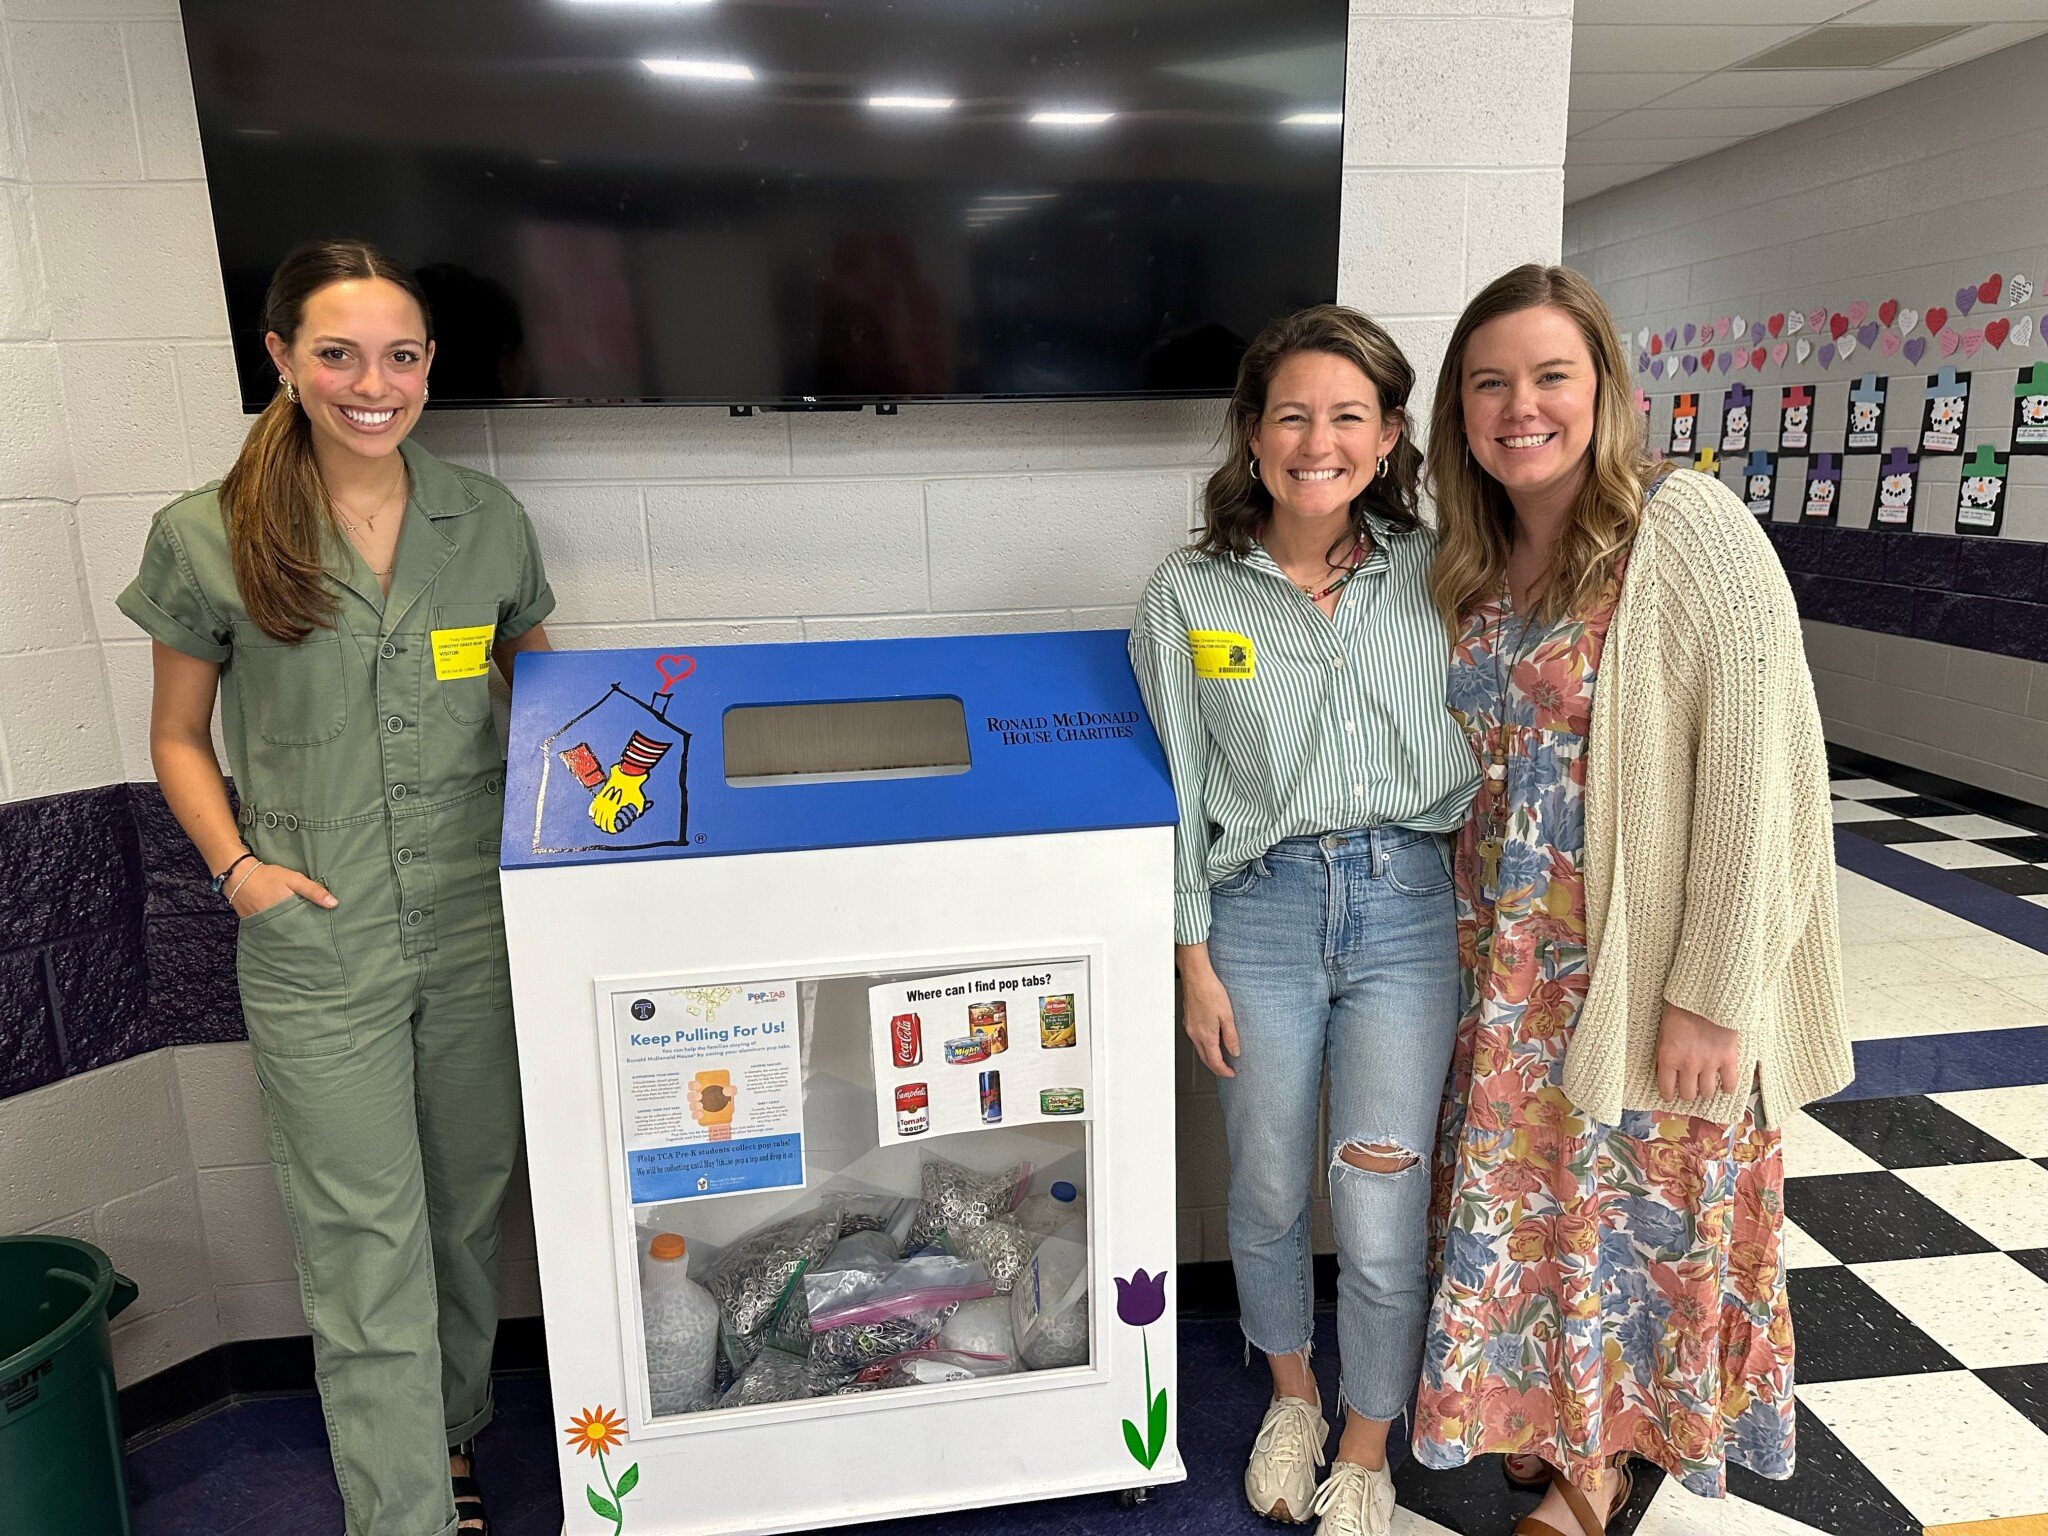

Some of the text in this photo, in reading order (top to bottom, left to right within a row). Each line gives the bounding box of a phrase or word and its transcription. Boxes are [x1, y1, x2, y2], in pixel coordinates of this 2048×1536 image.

[906, 973, 1052, 1002] Where can I find pop tabs?
[630, 1021, 785, 1047] Keep Pulling For Us!
[954, 1045, 980, 1057] Mighty
[900, 1116, 927, 1126] Tomato
[904, 1124, 923, 1132] SOUP
[637, 1155, 656, 1163] Help
[657, 1152, 673, 1160] TCA
[675, 1149, 697, 1158] Pre-K
[698, 1147, 730, 1155] students
[731, 1143, 756, 1152] collect
[773, 1139, 791, 1147] tabs!
[636, 1167, 646, 1175] We
[646, 1165, 656, 1174] will
[657, 1165, 663, 1173] be
[664, 1162, 690, 1172] collecting
[690, 1160, 703, 1169] until
[703, 1159, 715, 1168] May
[734, 1158, 745, 1166] pop
[749, 1156, 758, 1164] top
[759, 1153, 769, 1161] and
[769, 1152, 782, 1162] drop
